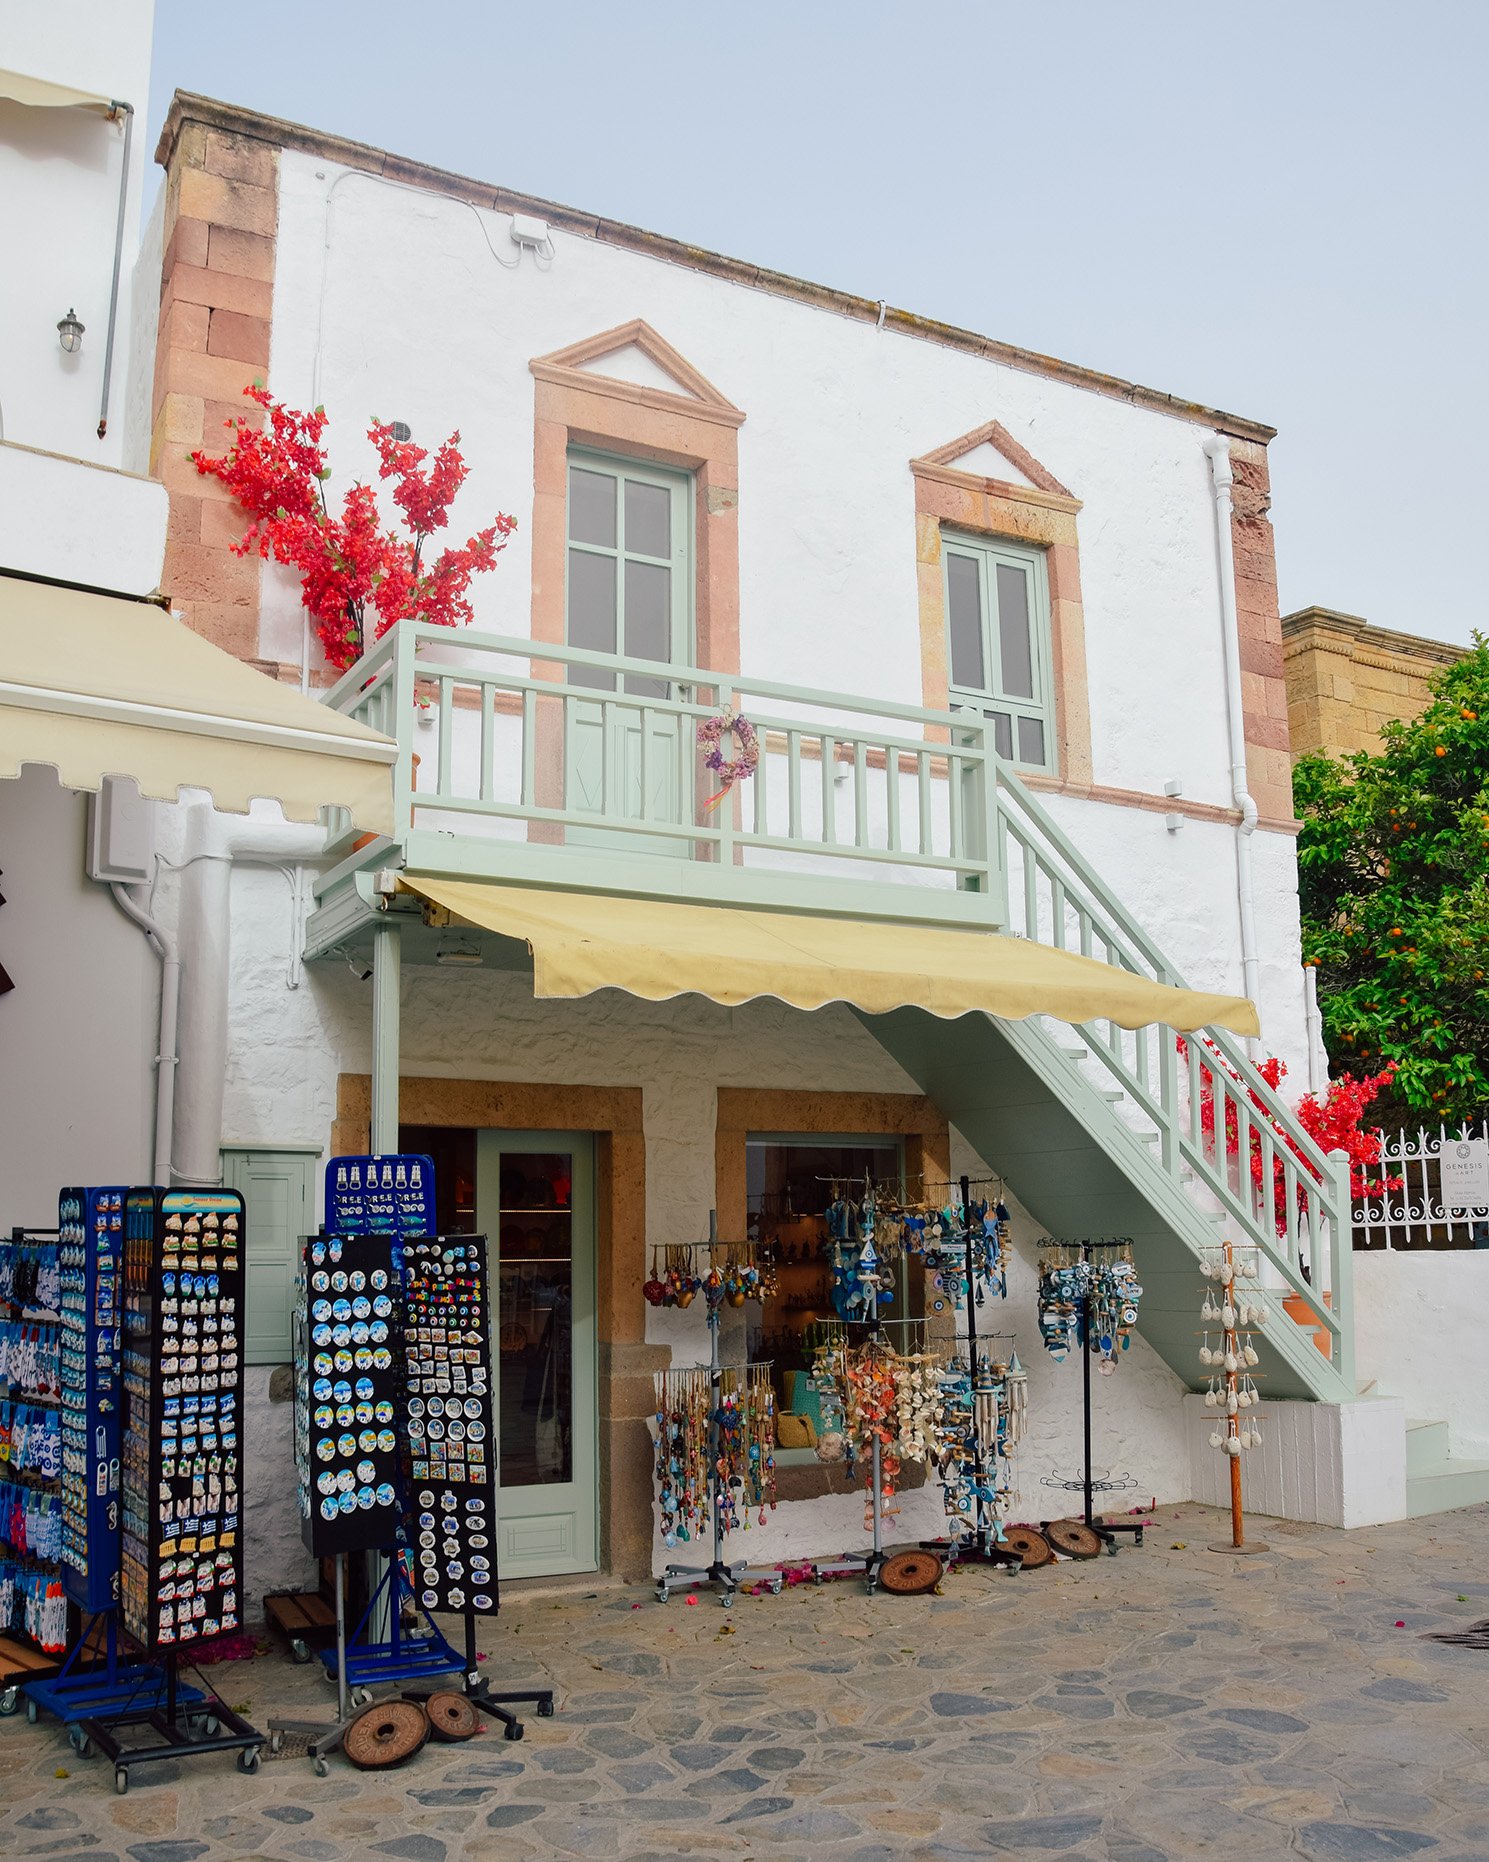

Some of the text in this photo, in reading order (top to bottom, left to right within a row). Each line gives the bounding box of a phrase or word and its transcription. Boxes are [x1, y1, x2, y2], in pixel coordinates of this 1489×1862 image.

[1445, 1162, 1483, 1170] GENESIS
[432, 1283, 456, 1291] PATMOS
[456, 1277, 481, 1289] PATMOS
[406, 1291, 429, 1301] PATMOS
[430, 1294, 454, 1304] PATMOS
[456, 1293, 481, 1302] PATMOS
[356, 1720, 376, 1759] WEIDER
